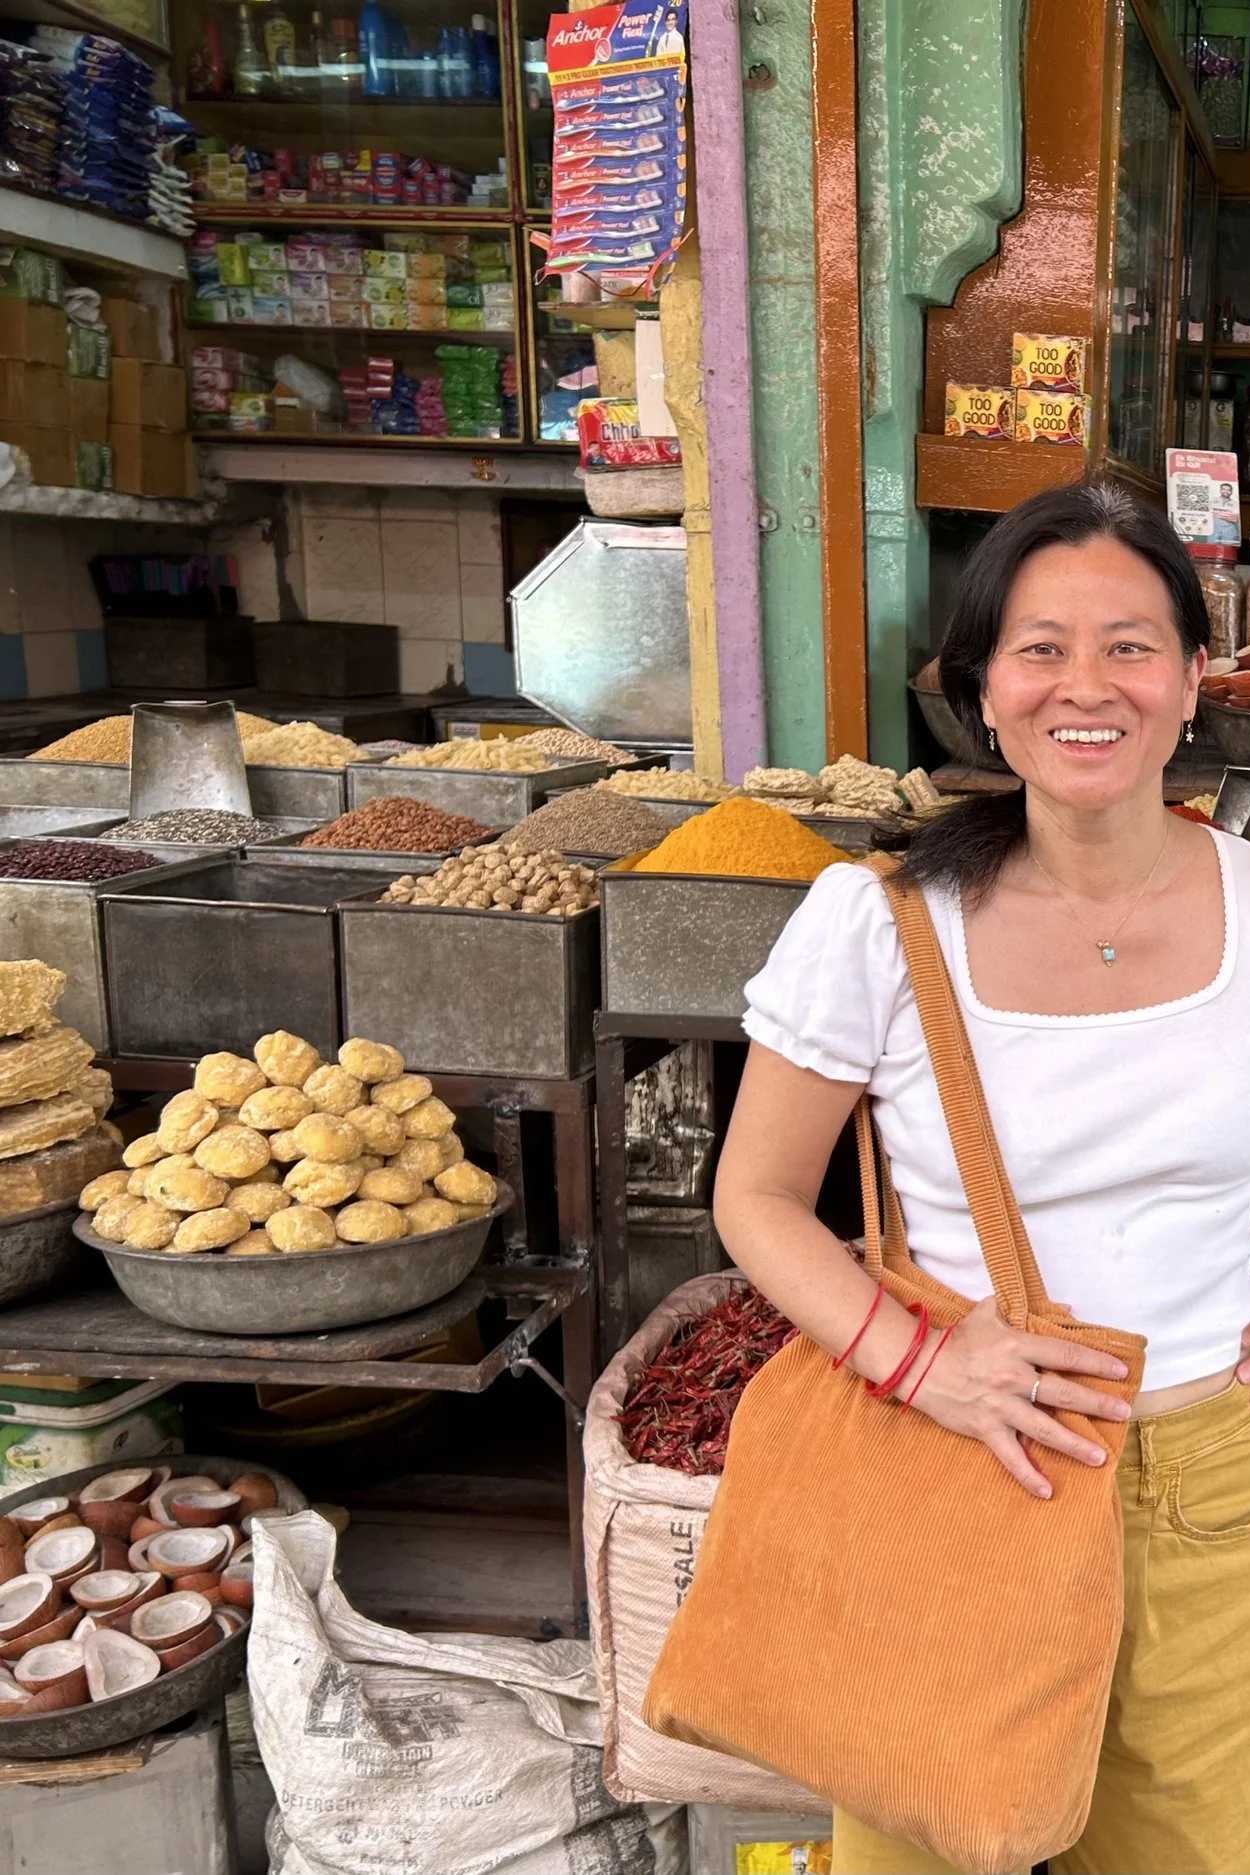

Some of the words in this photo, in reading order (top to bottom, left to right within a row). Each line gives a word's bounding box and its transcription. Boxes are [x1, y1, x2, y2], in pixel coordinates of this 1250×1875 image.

[618, 13, 652, 28] Power
[551, 25, 607, 47] Anchor
[570, 87, 596, 98] Anchor
[1035, 347, 1059, 361] TOO
[1029, 361, 1063, 375] GOOD
[968, 397, 992, 411] TOO
[1039, 403, 1062, 417] TOO
[963, 411, 996, 425] GOOD
[1033, 417, 1066, 431] GOOD
